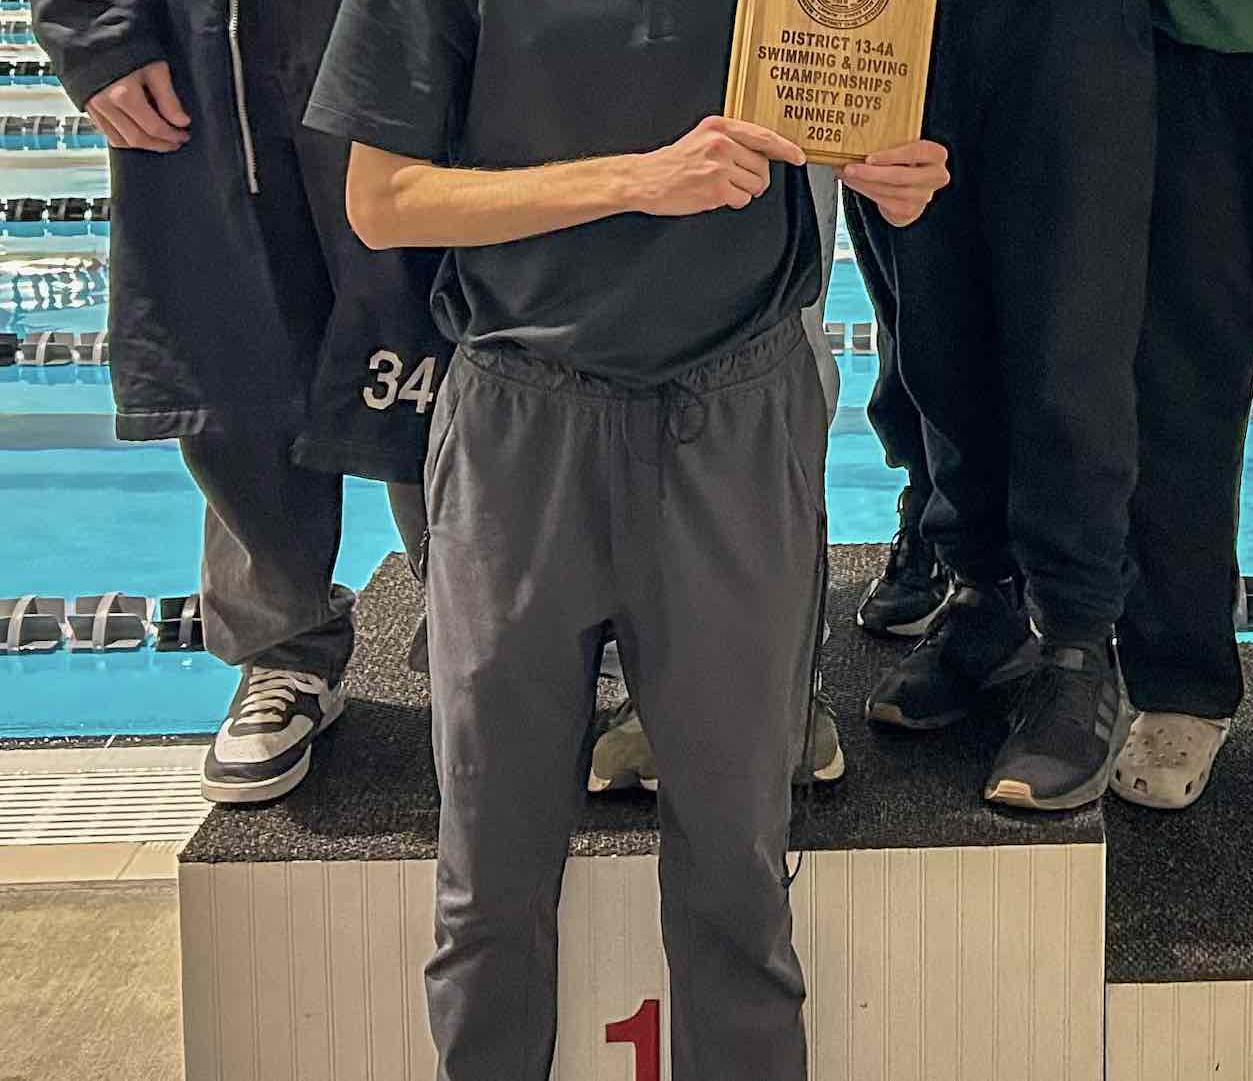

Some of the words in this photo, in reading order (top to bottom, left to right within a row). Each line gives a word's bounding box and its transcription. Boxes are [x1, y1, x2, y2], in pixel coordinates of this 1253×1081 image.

[781, 30, 850, 50] DISTRICT
[855, 39, 894, 57] 13-4A
[758, 46, 837, 68] SWIMMING
[841, 56, 850, 70] &
[857, 57, 908, 77] DIVING
[770, 66, 892, 94] CHAMPIONSHIPS
[776, 85, 839, 106] VARSITY
[844, 93, 882, 110] BOYS
[784, 105, 845, 125] RUNNER
[850, 112, 870, 128] UP
[807, 126, 842, 143] 2026
[363, 350, 436, 413] 34
[605, 999, 660, 1081] 1
